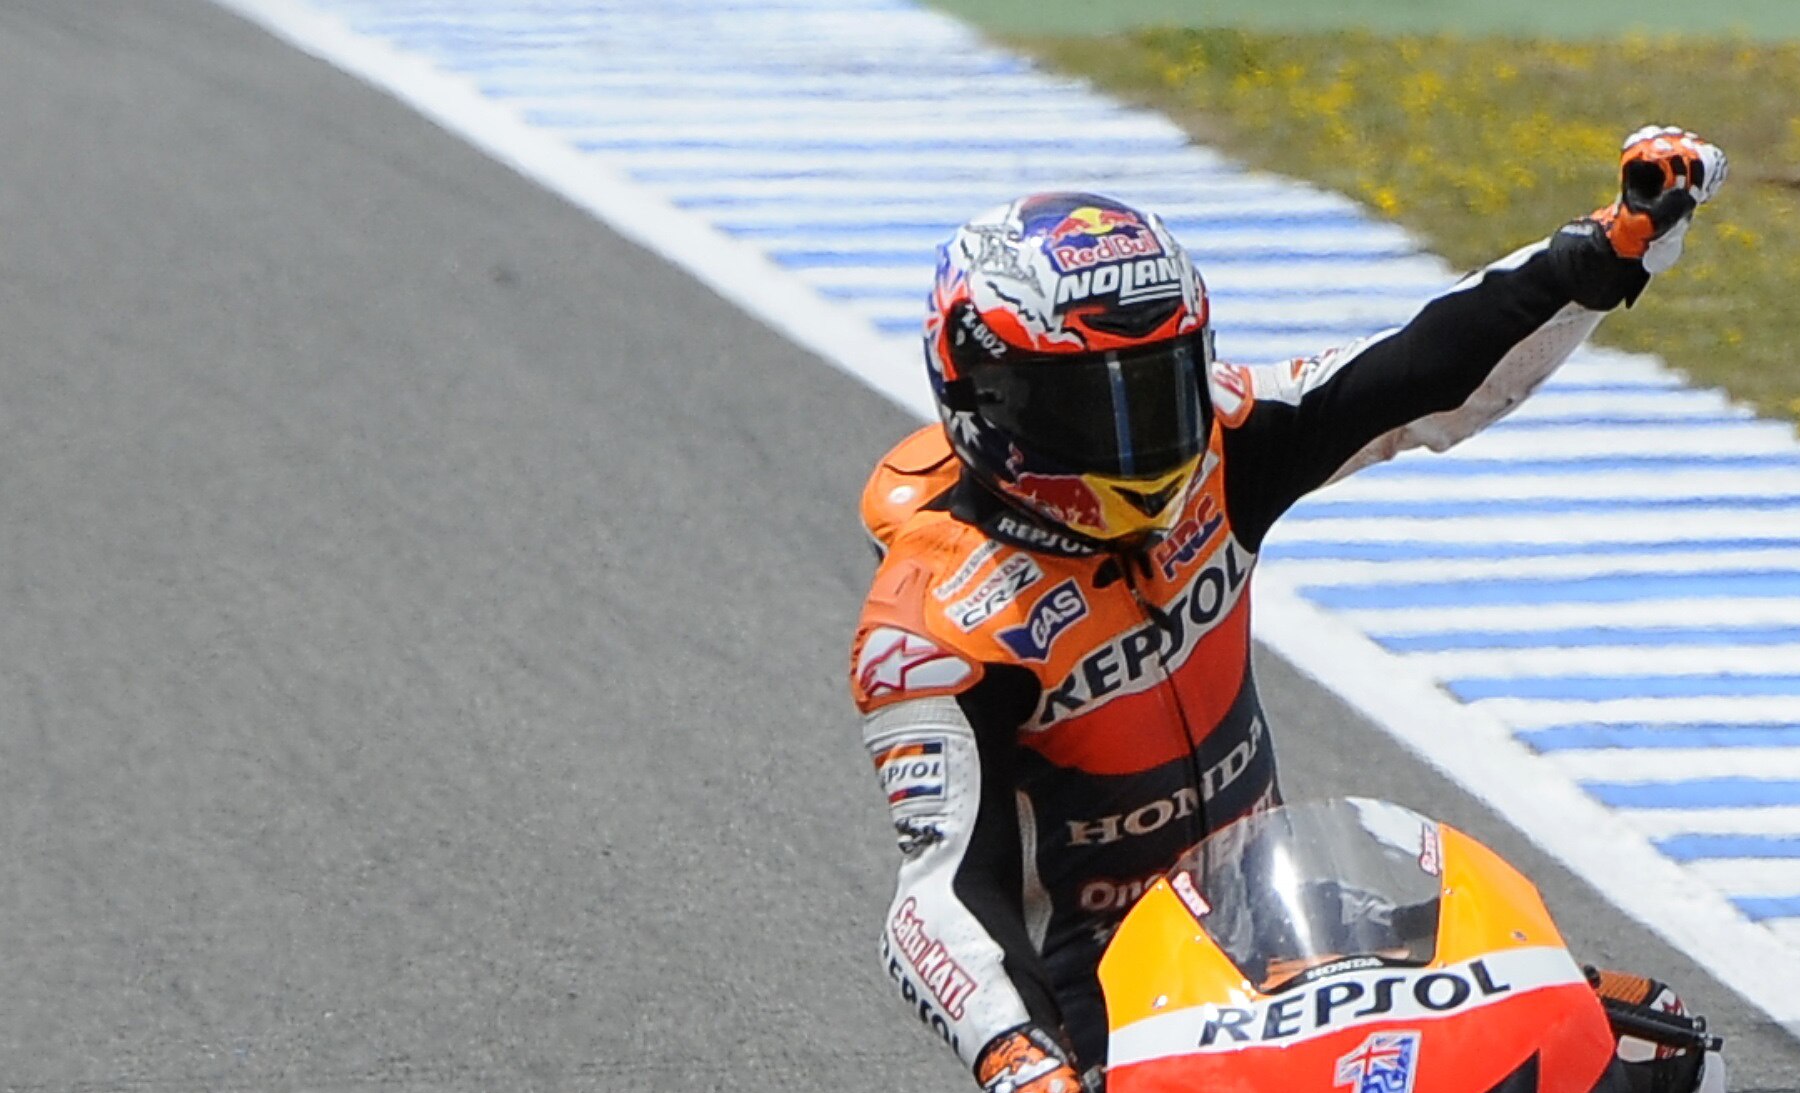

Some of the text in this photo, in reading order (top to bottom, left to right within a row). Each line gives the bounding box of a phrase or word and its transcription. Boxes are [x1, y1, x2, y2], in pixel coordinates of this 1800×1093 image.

[1055, 236, 1115, 269] Red
[1056, 256, 1183, 304] NOLAN
[1031, 590, 1082, 650] GAS
[1198, 960, 1511, 1047] REPSOL
